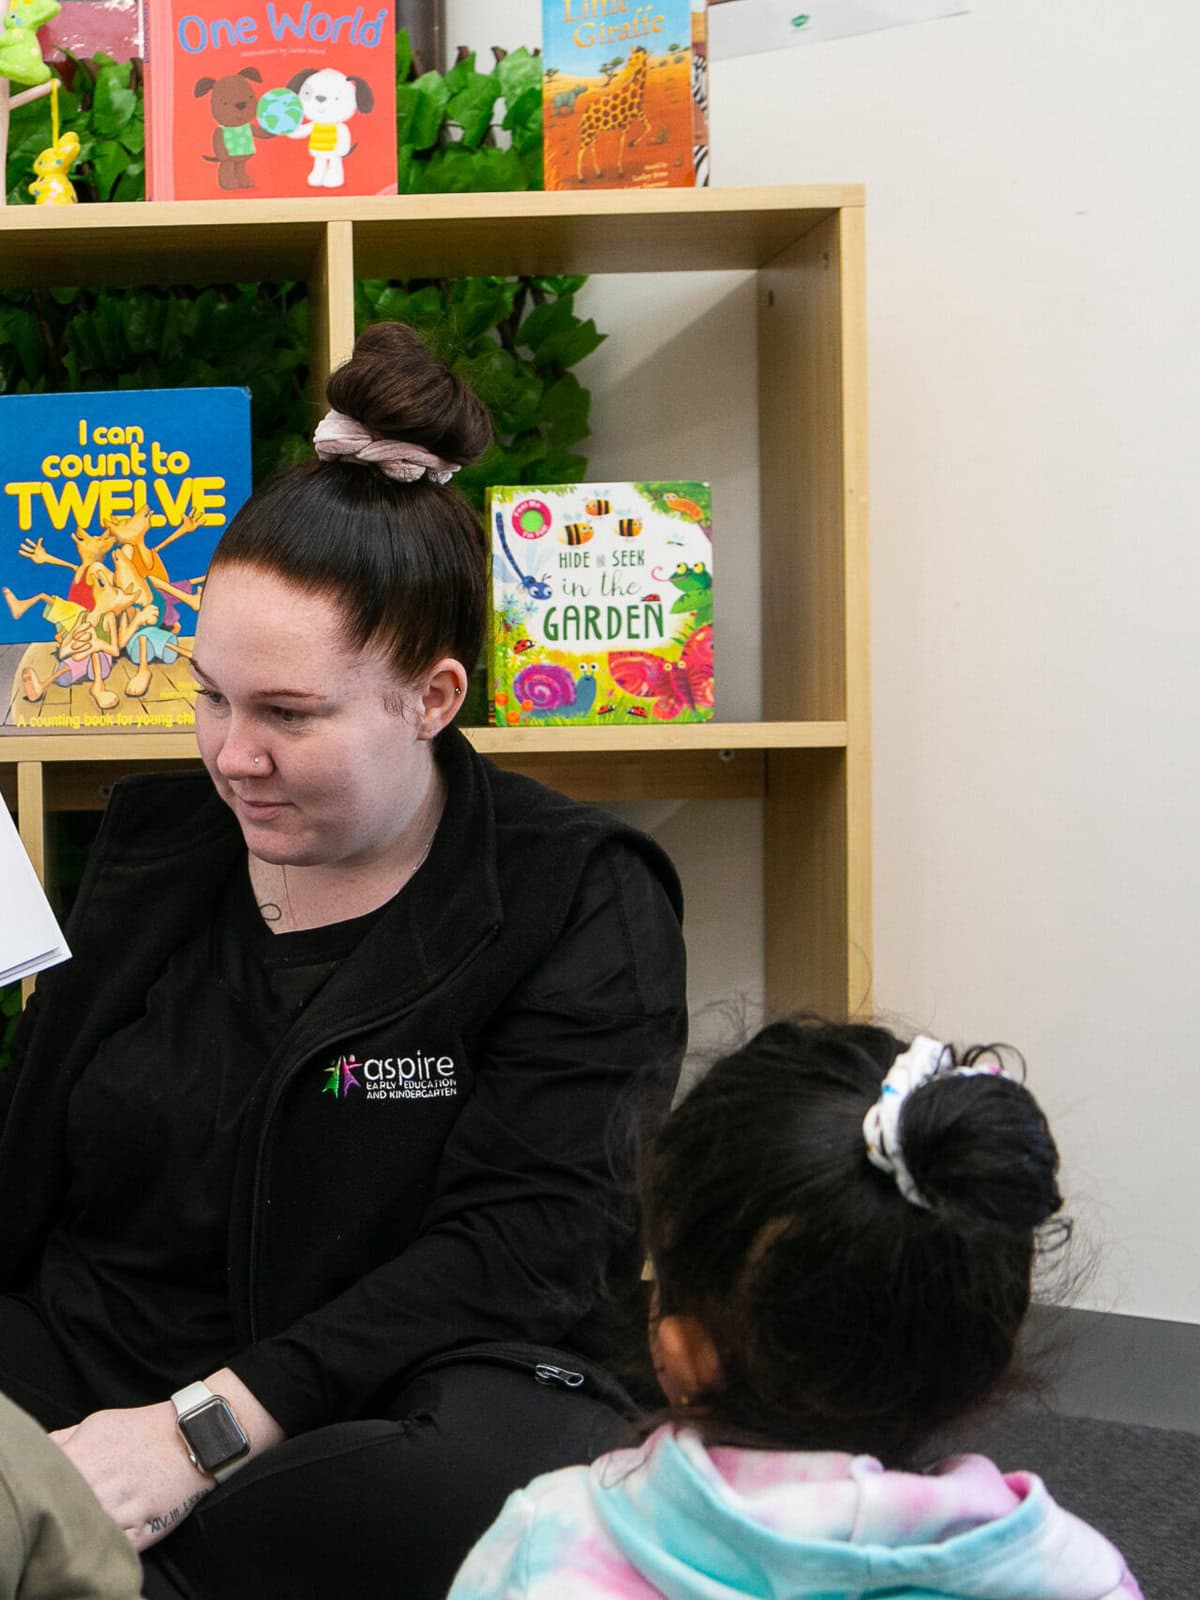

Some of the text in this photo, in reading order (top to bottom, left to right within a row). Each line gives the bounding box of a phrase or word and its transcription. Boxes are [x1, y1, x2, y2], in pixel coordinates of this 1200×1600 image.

[177, 15, 258, 54] One
[266, 2, 389, 48] World
[573, 6, 665, 48] Giraffe
[78, 418, 144, 446] I can
[41, 441, 190, 478] count to
[4, 476, 226, 531] TWELVE
[559, 551, 590, 569] HIDE
[612, 549, 645, 568] SEEK
[562, 569, 642, 598] in the
[543, 602, 665, 641] GARDEN
[17, 715, 26, 727] A
[29, 714, 80, 729] counting
[84, 713, 113, 726] book
[117, 713, 132, 726] for
[136, 714, 174, 729] young
[363, 1049, 455, 1086] aspire
[366, 1078, 457, 1090] EARLY EDUCATION
[366, 1087, 457, 1099] AND KINDERGARTEN
